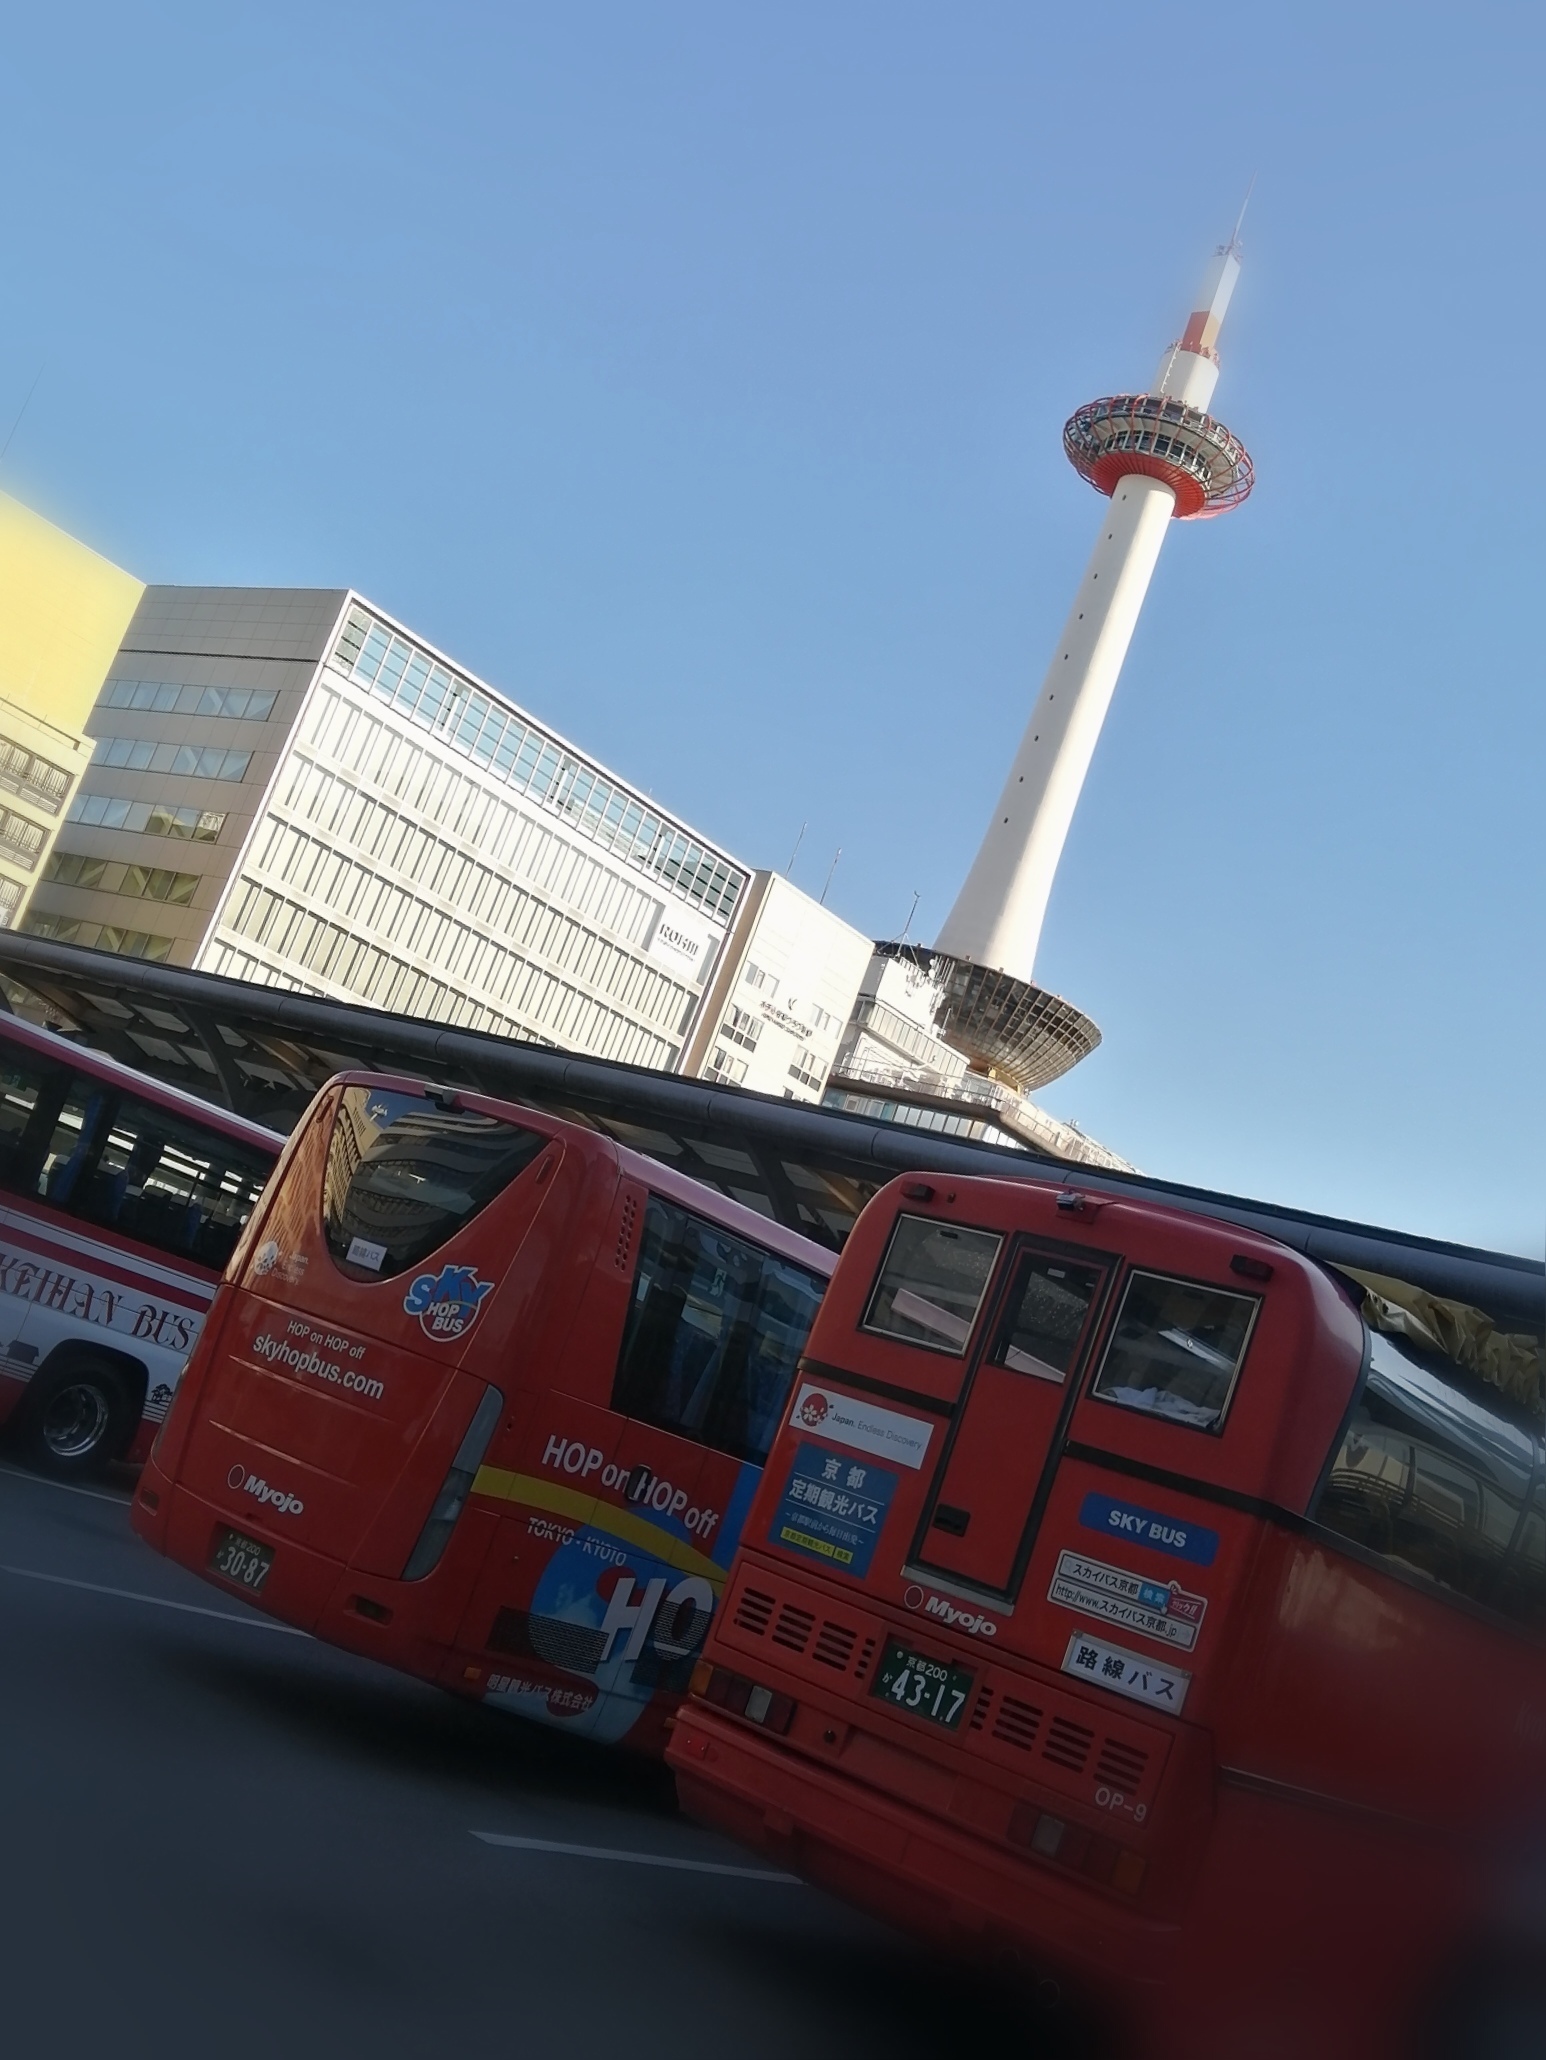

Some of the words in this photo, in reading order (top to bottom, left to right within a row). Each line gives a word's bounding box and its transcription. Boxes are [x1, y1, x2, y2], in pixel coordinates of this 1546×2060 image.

[0, 1252, 123, 1327] KEIHAN
[131, 1304, 195, 1350] BUS
[403, 1264, 494, 1318] SKY
[427, 1301, 460, 1318] HOP
[287, 1320, 310, 1338] HOP
[309, 1331, 322, 1344] on
[324, 1335, 349, 1355] HOP
[349, 1346, 366, 1361] off
[431, 1316, 464, 1334] BUS
[253, 1333, 384, 1399] skyhopbus.com
[831, 1411, 855, 1429] Japan.
[857, 1420, 885, 1439] Endless
[885, 1428, 923, 1451] Discovery
[541, 1434, 604, 1478] HOP
[601, 1464, 629, 1491] on
[633, 1471, 688, 1517] HOP
[684, 1509, 719, 1539] off
[821, 1458, 867, 1490] 京都
[243, 1475, 304, 1515] Myojo
[789, 1479, 878, 1526] 定期観光バス
[527, 1517, 575, 1546] TOKYO
[583, 1536, 627, 1567] KYOTO
[1108, 1510, 1147, 1535] SKY
[1148, 1522, 1187, 1548] BUS
[1072, 1562, 1138, 1596] スカイバス京都
[1143, 1587, 1166, 1605] 検索
[925, 1596, 998, 1637] Myojo
[1055, 1583, 1178, 1638] http://www.スカイバス京都.jp
[905, 1655, 949, 1682] 京都200
[1075, 1645, 1175, 1701] 路線バス
[1094, 1787, 1148, 1823] OP-9
